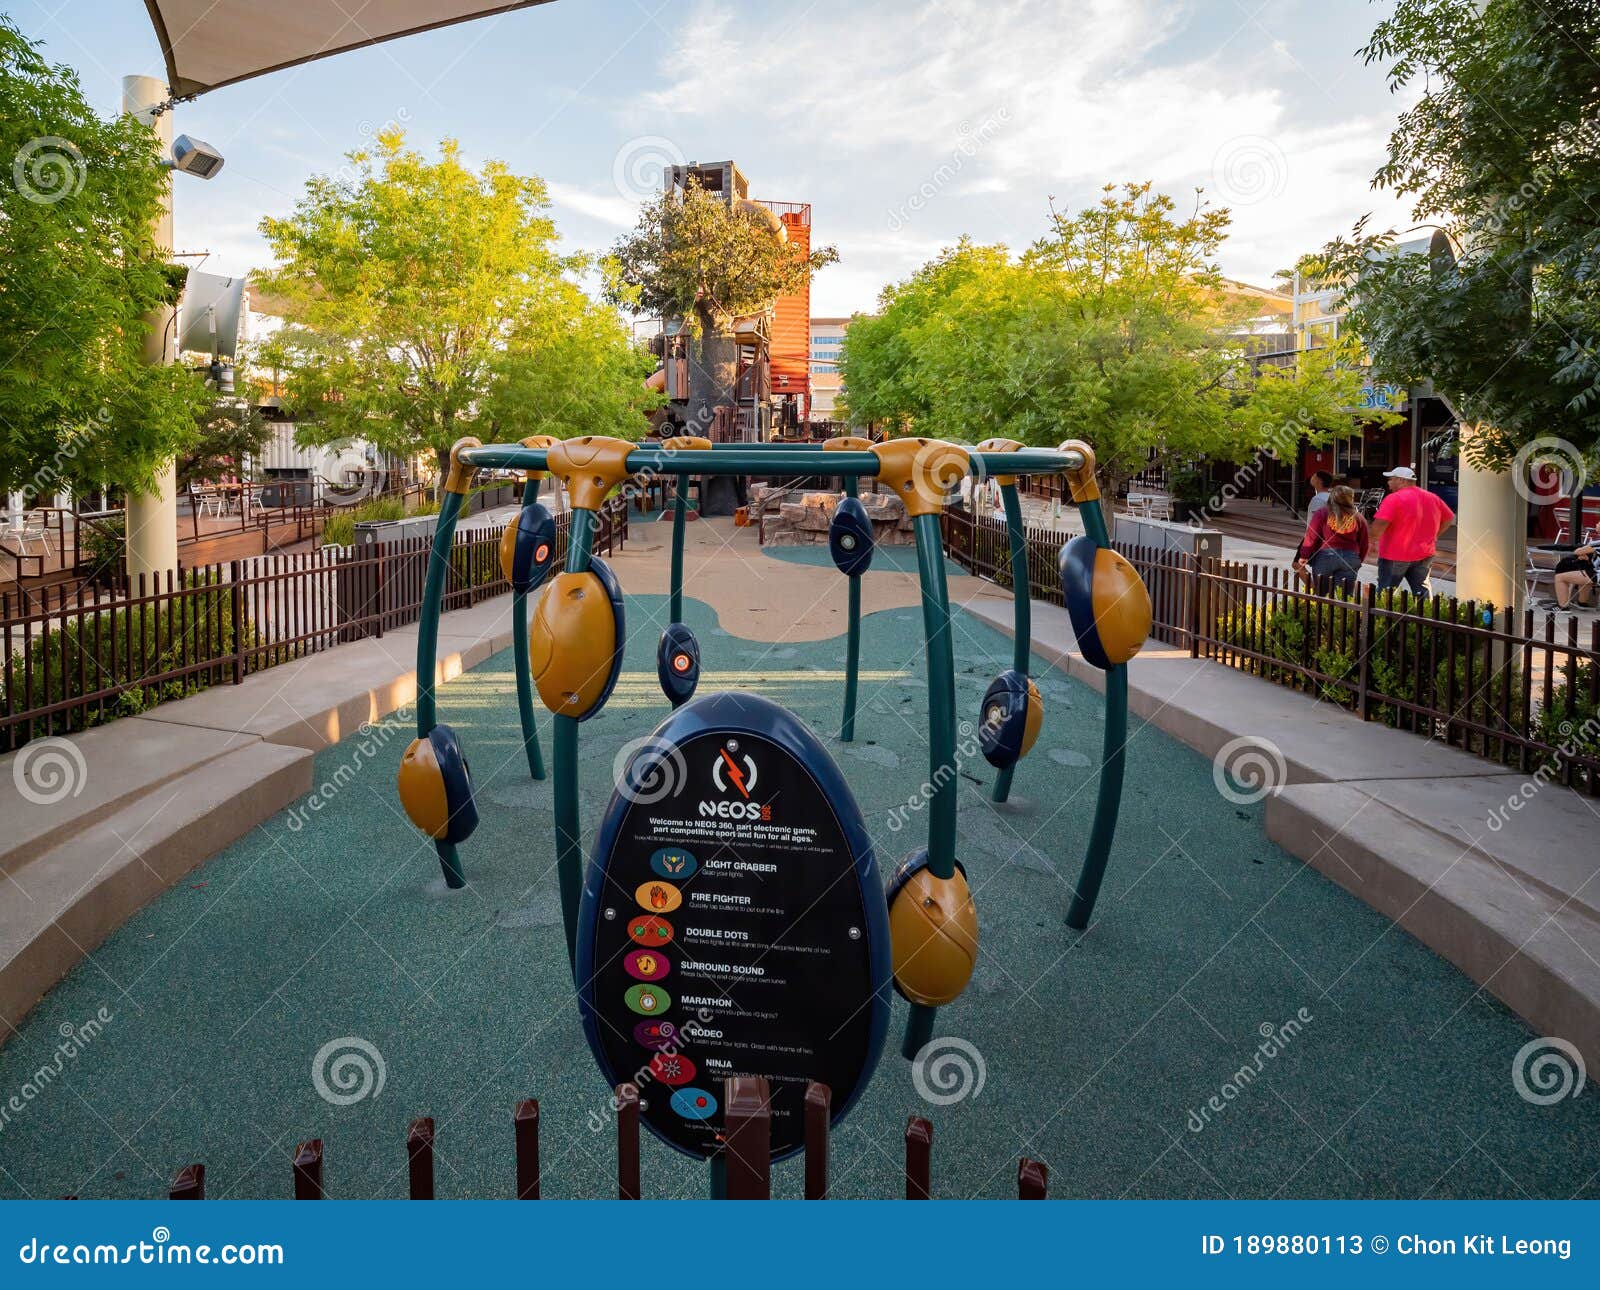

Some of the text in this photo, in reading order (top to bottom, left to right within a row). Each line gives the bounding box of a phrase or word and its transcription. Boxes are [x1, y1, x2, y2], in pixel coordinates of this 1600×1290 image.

[699, 800, 761, 820] NEOS
[649, 817, 683, 826] Welcome
[695, 821, 717, 829] NEOS
[719, 822, 735, 831] 360,
[736, 823, 751, 831] part
[753, 824, 792, 833] electronic
[653, 826, 668, 834] part
[670, 827, 714, 836] competitive
[716, 830, 736, 838] sport
[738, 831, 752, 839] and
[768, 833, 779, 841] for
[706, 860, 777, 873] LIGHT GRABBER
[691, 892, 751, 905] FIRE FIGHTER
[686, 927, 749, 940] DOUBLE DOTS
[681, 960, 765, 976] SURROUND SOUND
[681, 995, 732, 1007] MARATHON
[691, 1028, 723, 1038] RODEO
[705, 1058, 733, 1069] NINJA
